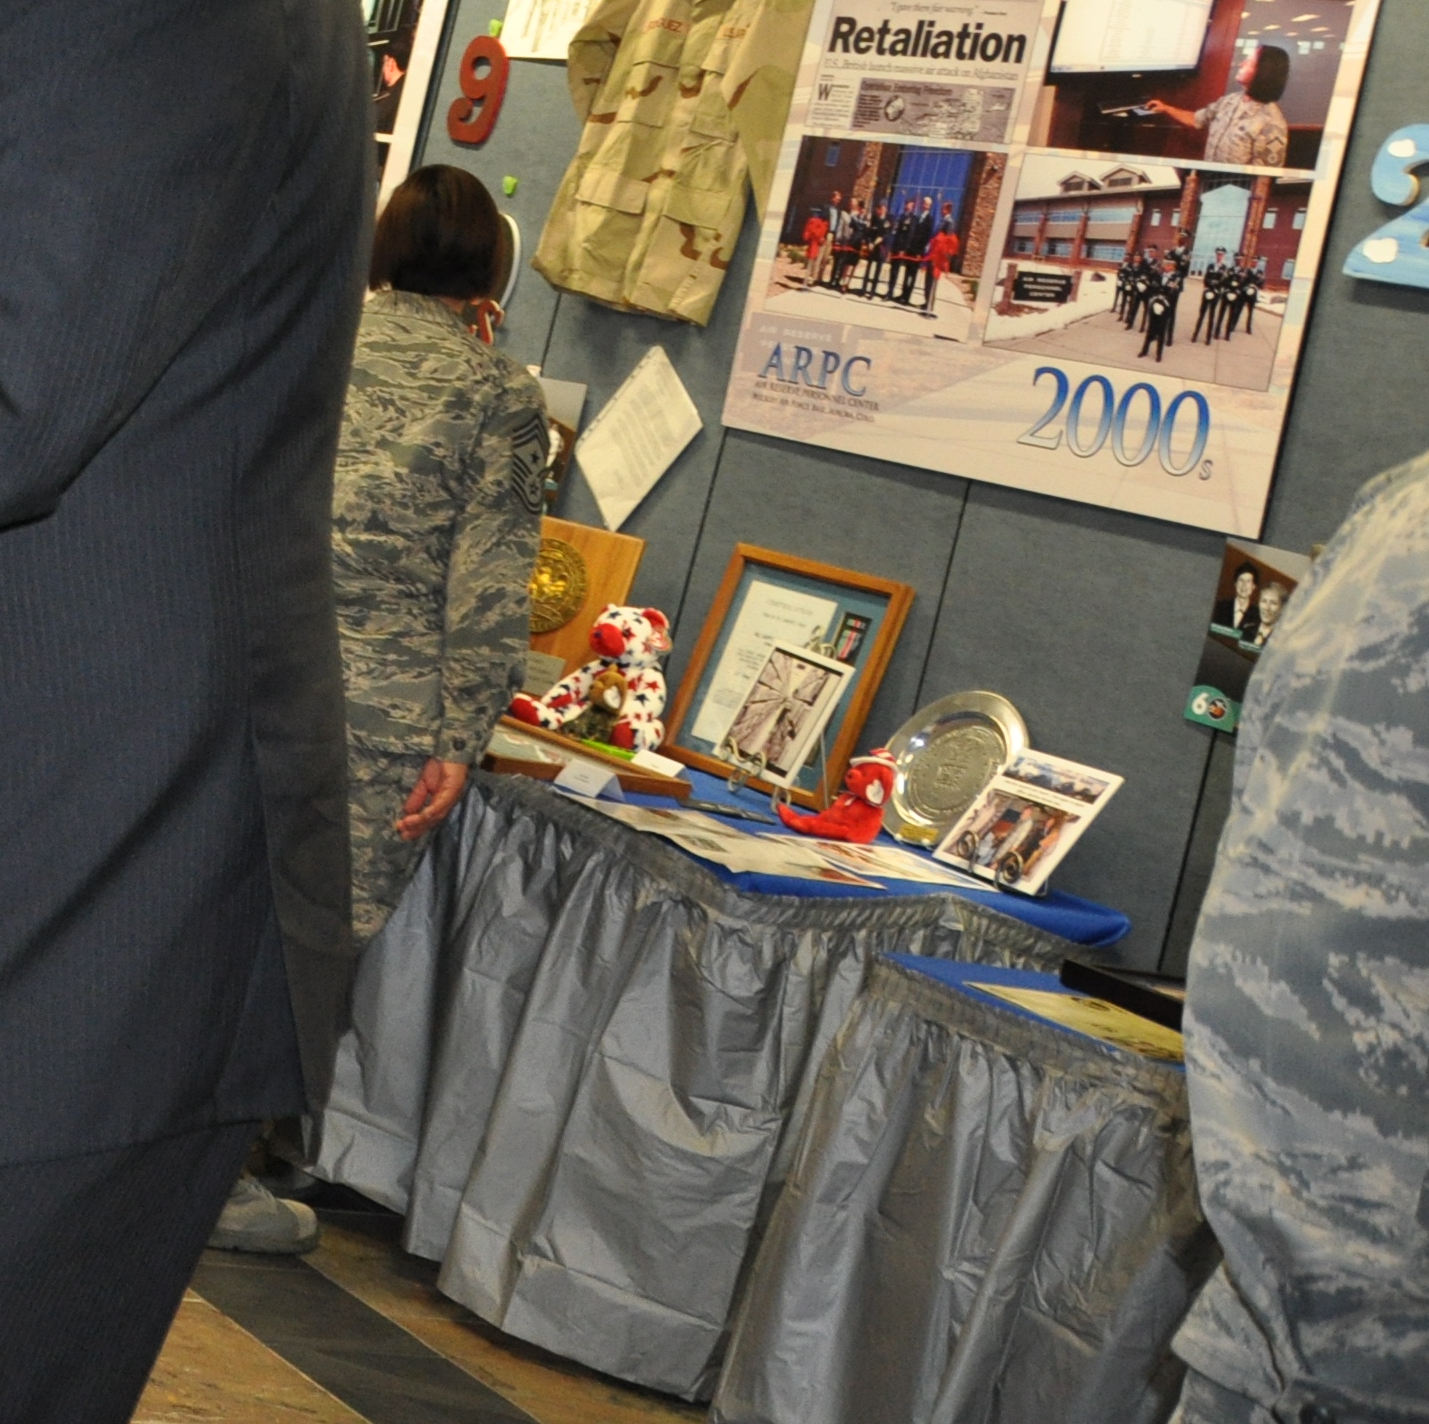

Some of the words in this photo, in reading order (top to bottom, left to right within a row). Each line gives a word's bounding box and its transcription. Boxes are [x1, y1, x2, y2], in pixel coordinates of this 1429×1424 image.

[828, 16, 1027, 64] Retaliation
[758, 342, 871, 397] ARPC
[1017, 366, 1213, 480] 2000s
